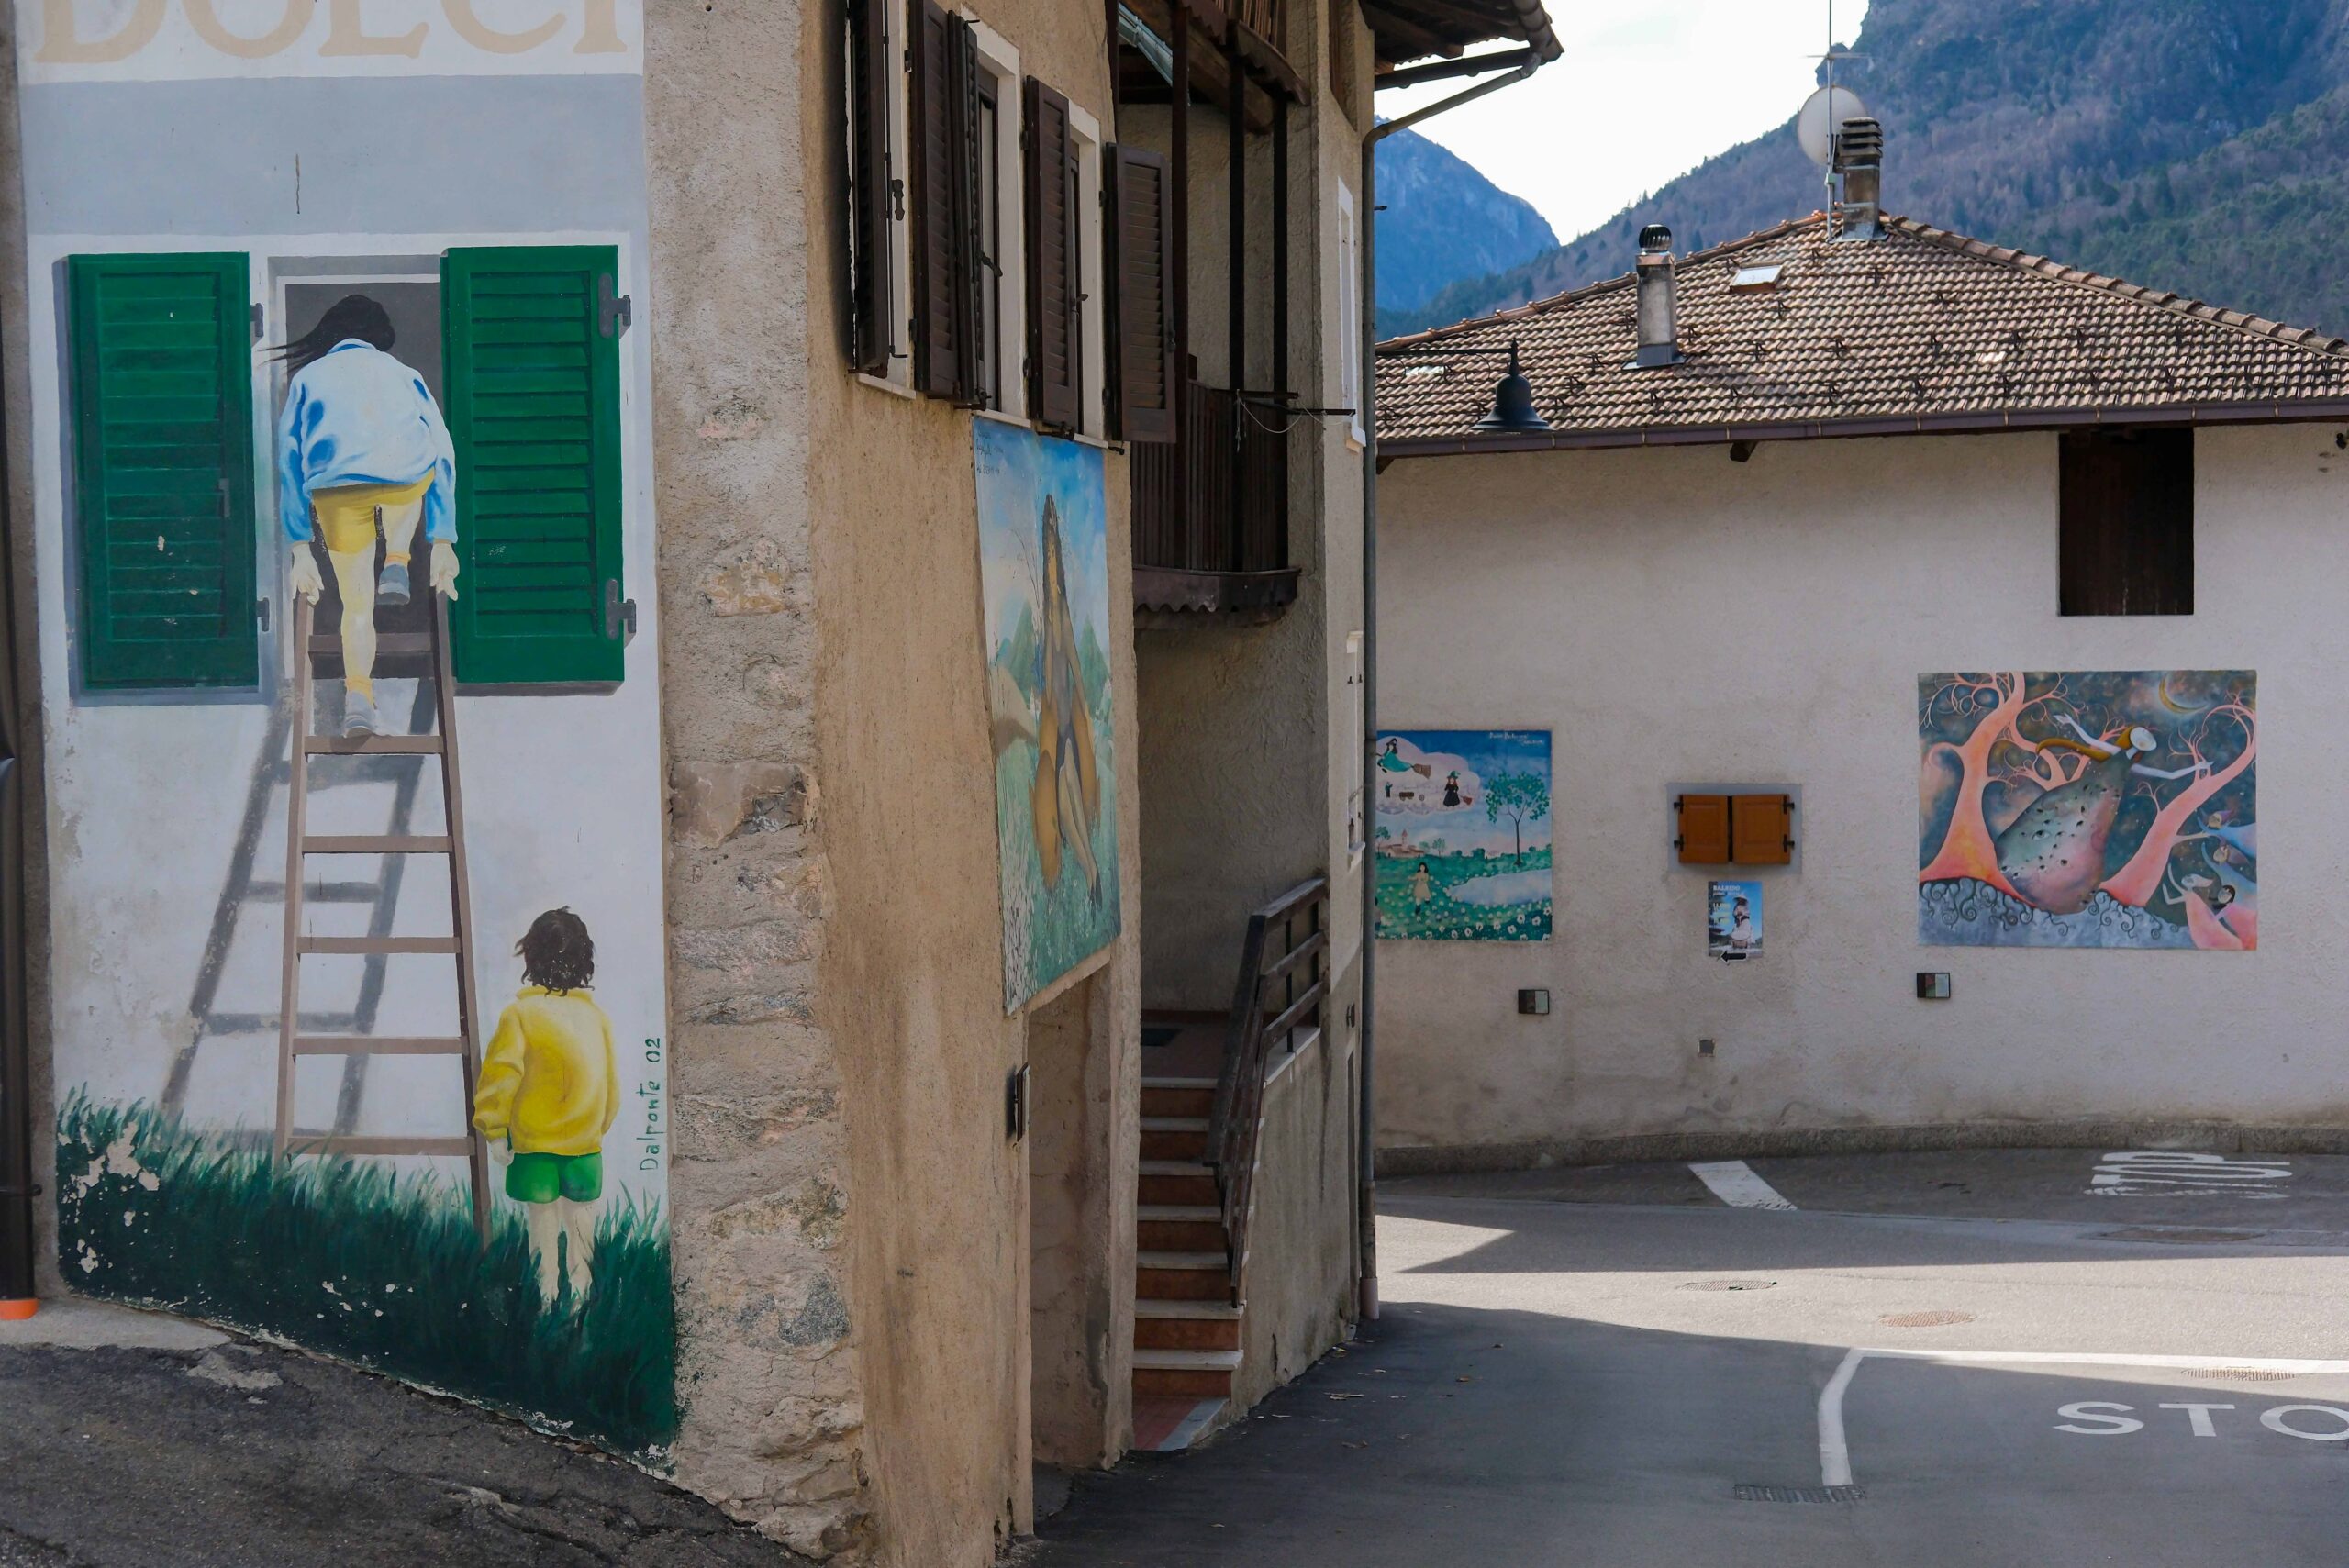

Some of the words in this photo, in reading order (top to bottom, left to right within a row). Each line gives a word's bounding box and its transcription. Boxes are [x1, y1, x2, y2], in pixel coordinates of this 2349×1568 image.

[645, 1038, 661, 1063] 02
[636, 1081, 666, 1171] Dalponte
[2052, 1401, 2349, 1440] STO
